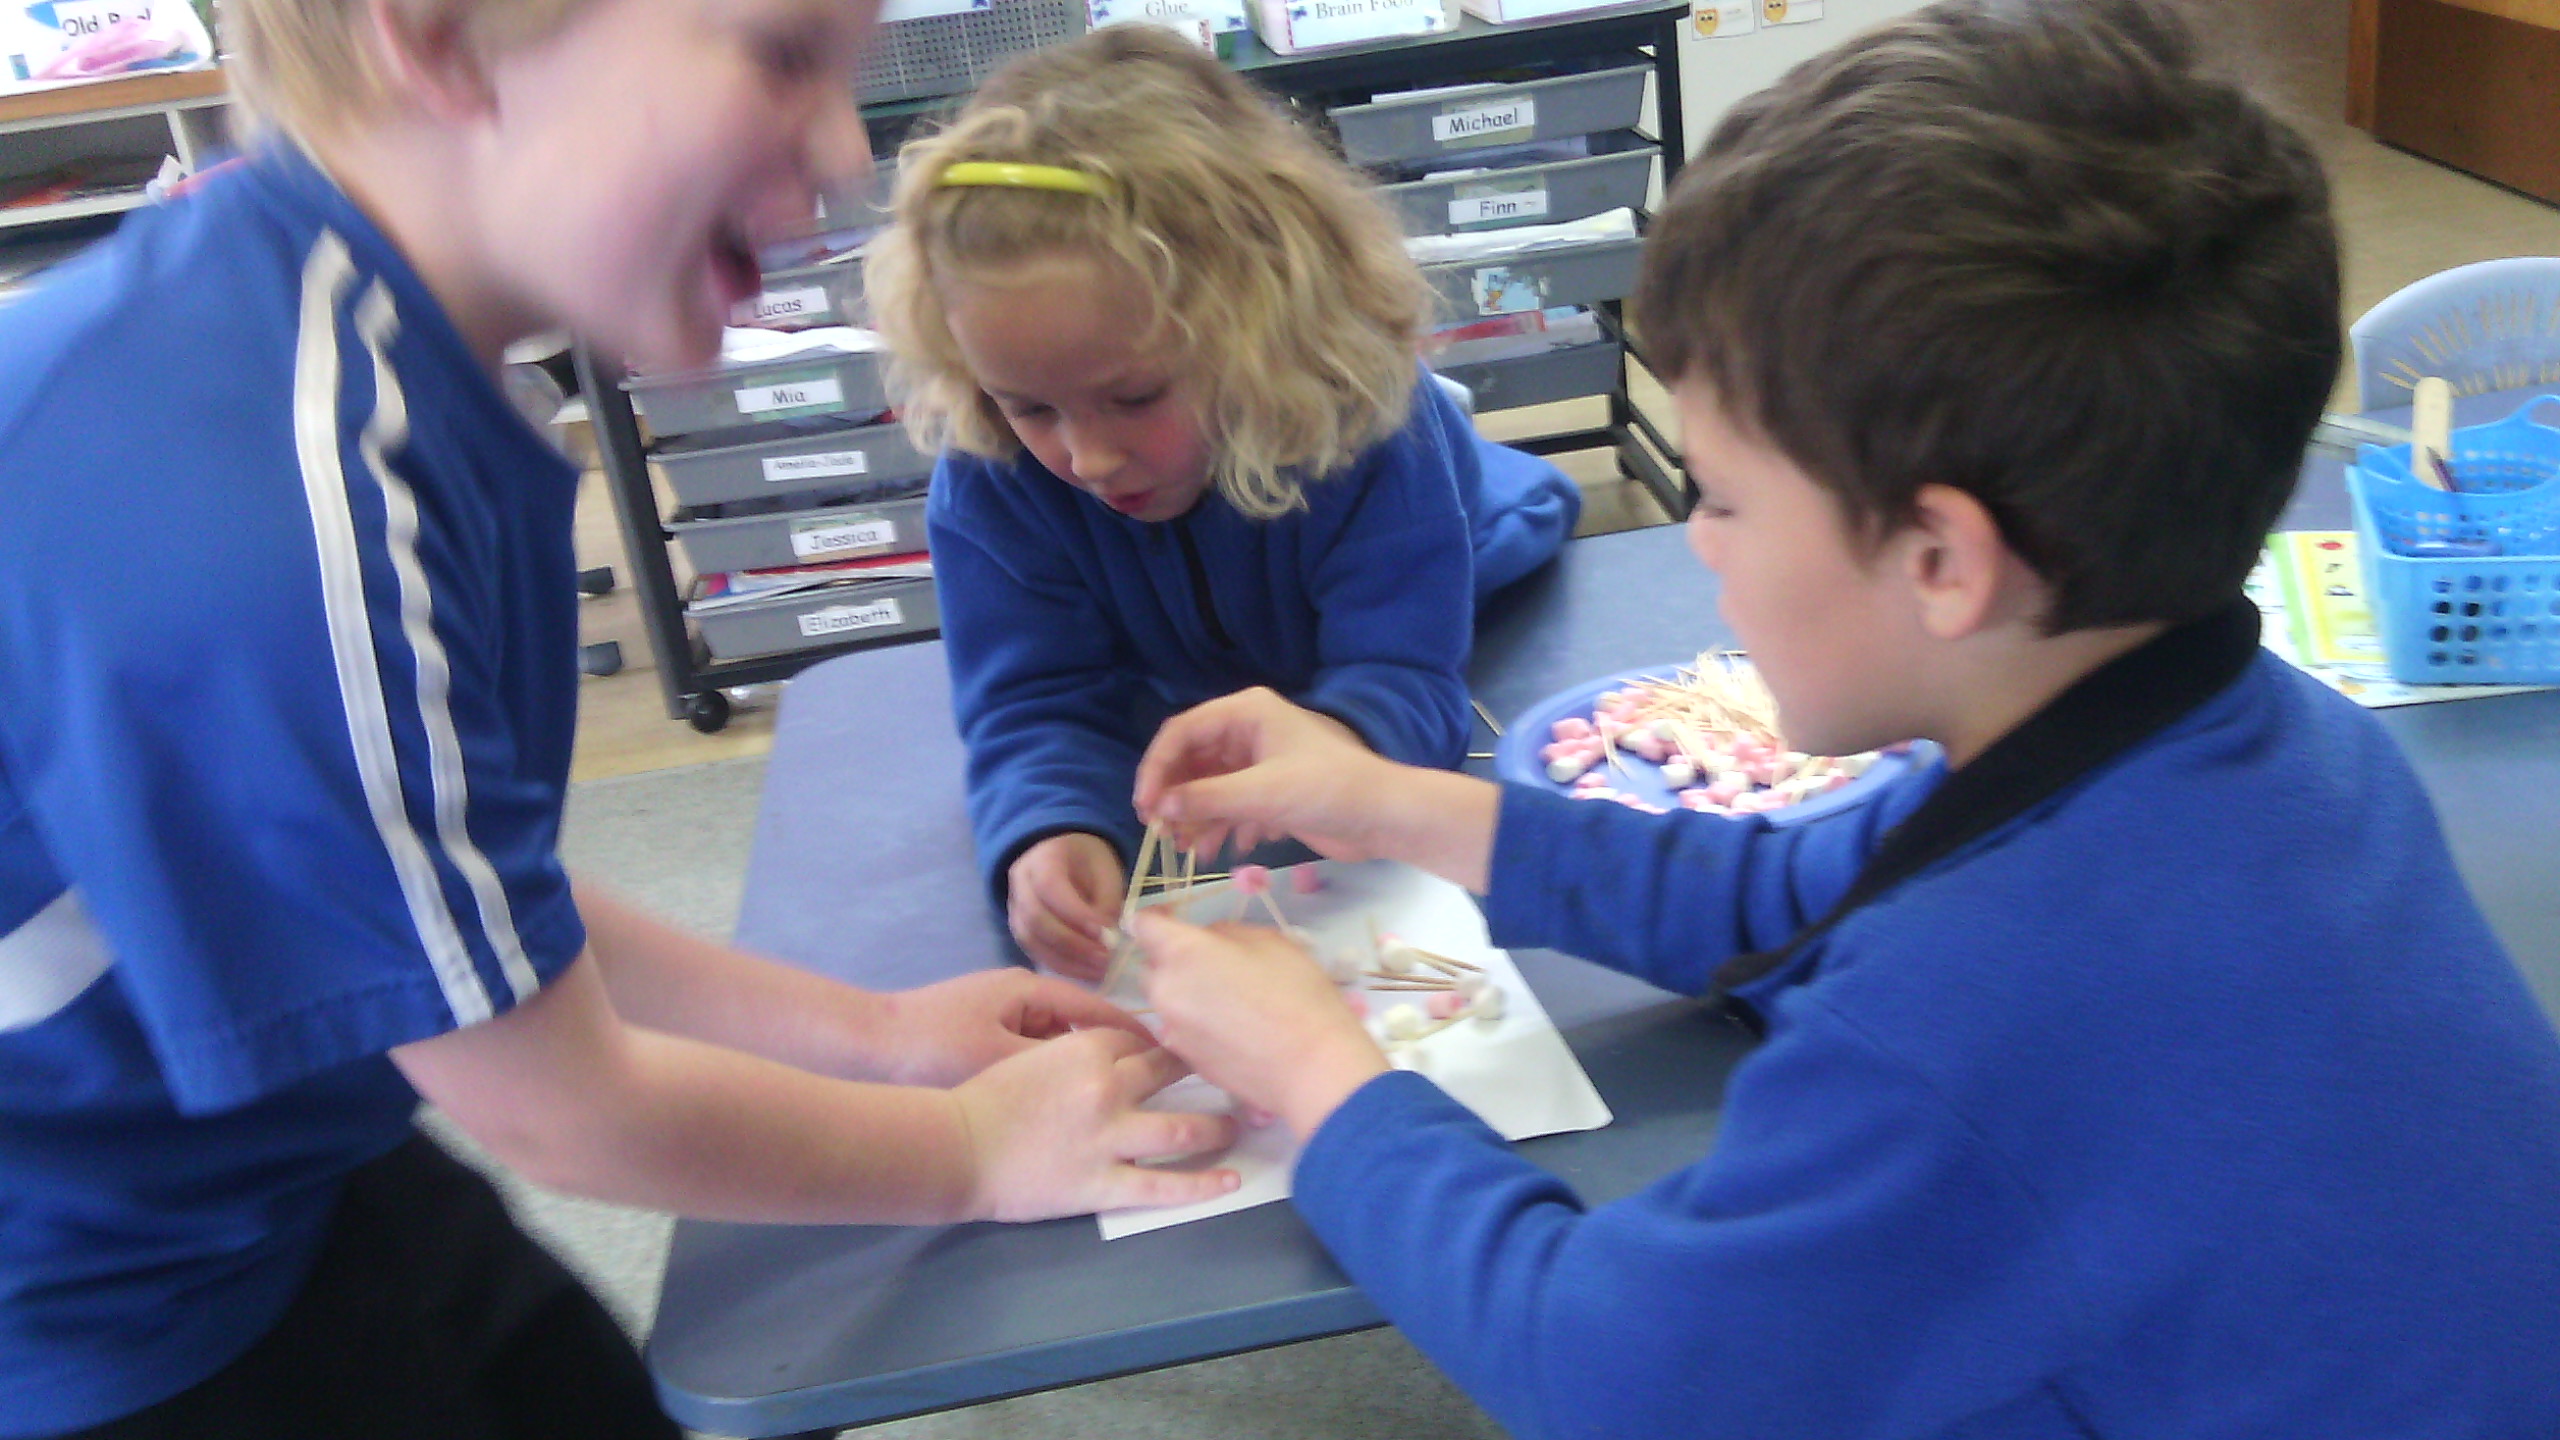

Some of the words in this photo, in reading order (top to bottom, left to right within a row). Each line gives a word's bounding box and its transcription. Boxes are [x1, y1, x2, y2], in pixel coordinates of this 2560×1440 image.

[1145, 0, 1188, 16] Glue
[1315, 2, 1364, 19] Brain
[62, 14, 99, 37] Old
[1449, 106, 1518, 134] Michael
[1479, 200, 1517, 217] Finn
[754, 299, 802, 319] Lucas
[772, 389, 806, 405] Mia
[809, 531, 878, 550] Jessica
[807, 609, 891, 632] Elizabeth
